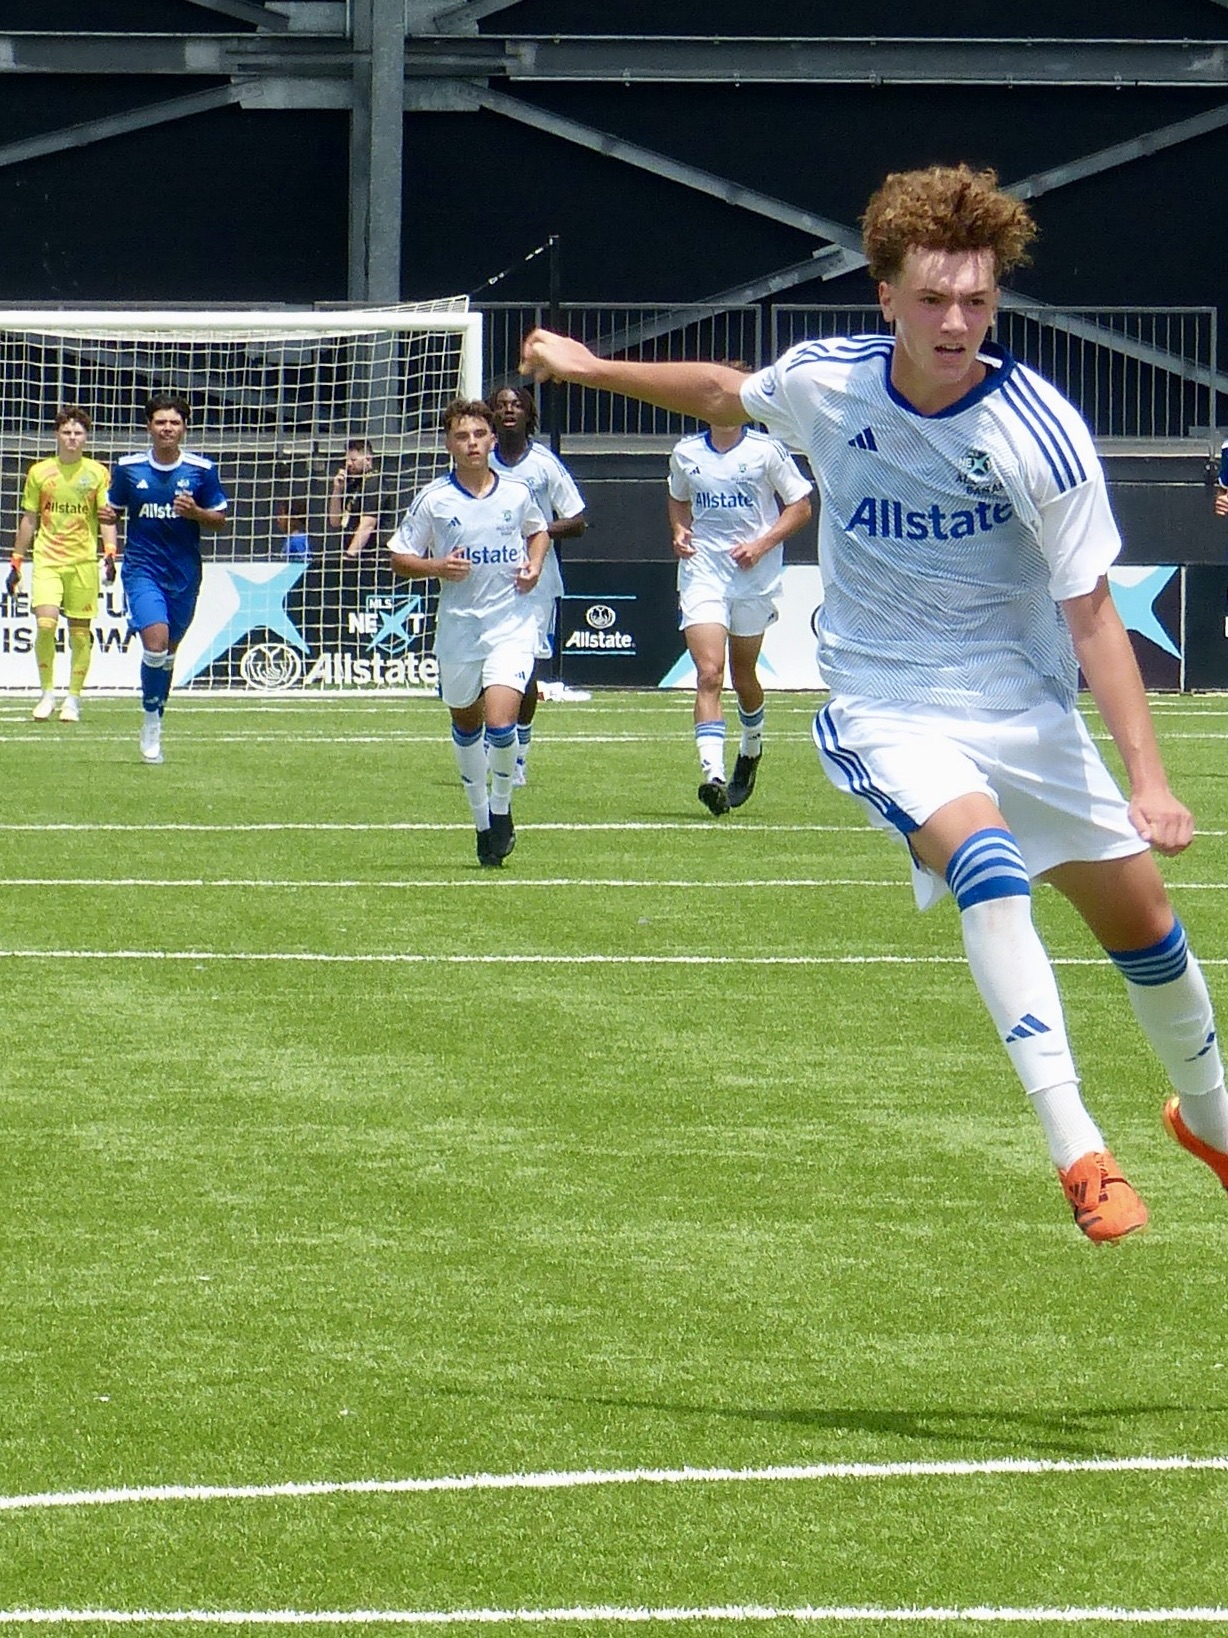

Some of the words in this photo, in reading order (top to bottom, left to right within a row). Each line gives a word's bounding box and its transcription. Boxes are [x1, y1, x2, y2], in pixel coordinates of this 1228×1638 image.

[45, 502, 88, 514] Allstate
[696, 492, 754, 508] Allstate
[139, 503, 180, 519] Allst
[844, 497, 1013, 541] Allstate
[3, 627, 32, 653] IS
[565, 631, 632, 648] Allstate
[305, 652, 439, 684] Allstate
